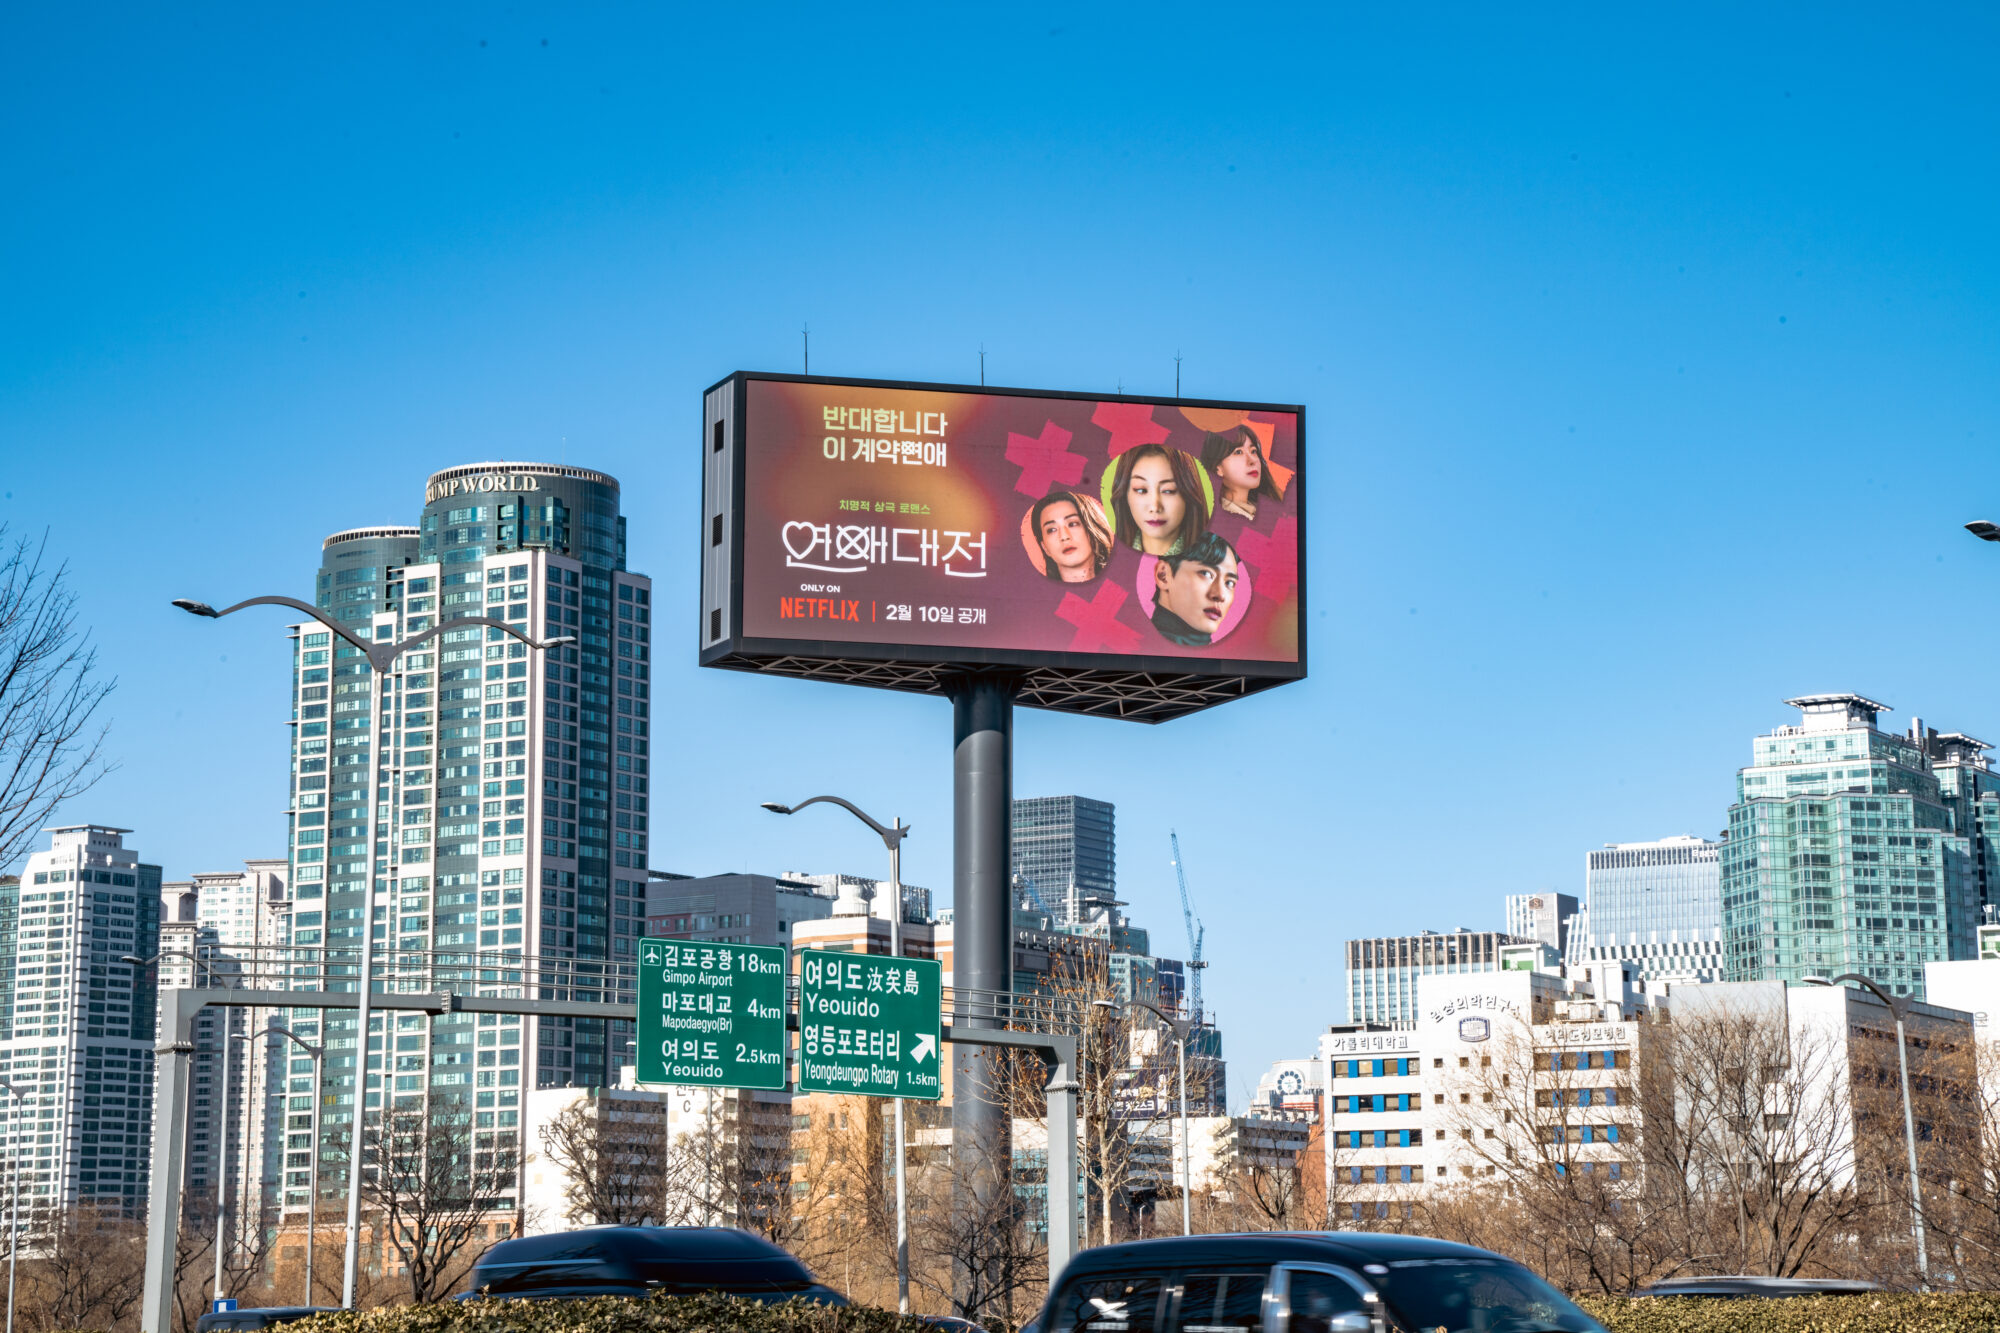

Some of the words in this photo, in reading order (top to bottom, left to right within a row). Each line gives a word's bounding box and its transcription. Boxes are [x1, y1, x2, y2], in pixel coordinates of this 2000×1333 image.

[823, 406, 948, 437] 반대합니다
[823, 437, 846, 461] 이
[425, 480, 460, 506] RUMP
[461, 475, 538, 494] WORLD
[839, 499, 870, 512] 치명적
[874, 501, 895, 513] 상극
[899, 503, 931, 515] 로맨스
[782, 521, 987, 578] 연애대전
[800, 583, 825, 593] ONLY
[826, 585, 840, 593] ON
[780, 596, 860, 623] NETFLIX
[886, 604, 912, 621] 2월
[918, 606, 954, 623] 10일
[957, 607, 986, 625] 공개
[664, 945, 733, 971] 김포공항
[738, 953, 781, 974] 18km
[662, 969, 696, 987] Gimpo
[698, 971, 733, 989] Airport
[805, 958, 864, 991] 여의도
[867, 966, 919, 995] 汝矣島
[662, 991, 733, 1014] 마포대교
[747, 998, 781, 1019] 4km
[806, 992, 880, 1018] Yeouido
[662, 1014, 733, 1034] Mapodaegyo(Br)
[662, 1038, 720, 1061] 여의도
[735, 1043, 781, 1065] 2.5km
[804, 1024, 900, 1062] 영등포로터리
[662, 1061, 724, 1078] Yeouido
[804, 1058, 869, 1087] Yeongdeungpo
[871, 1064, 899, 1090] Rotary
[906, 1071, 937, 1087] 1.5km
[682, 1099, 691, 1113] C
